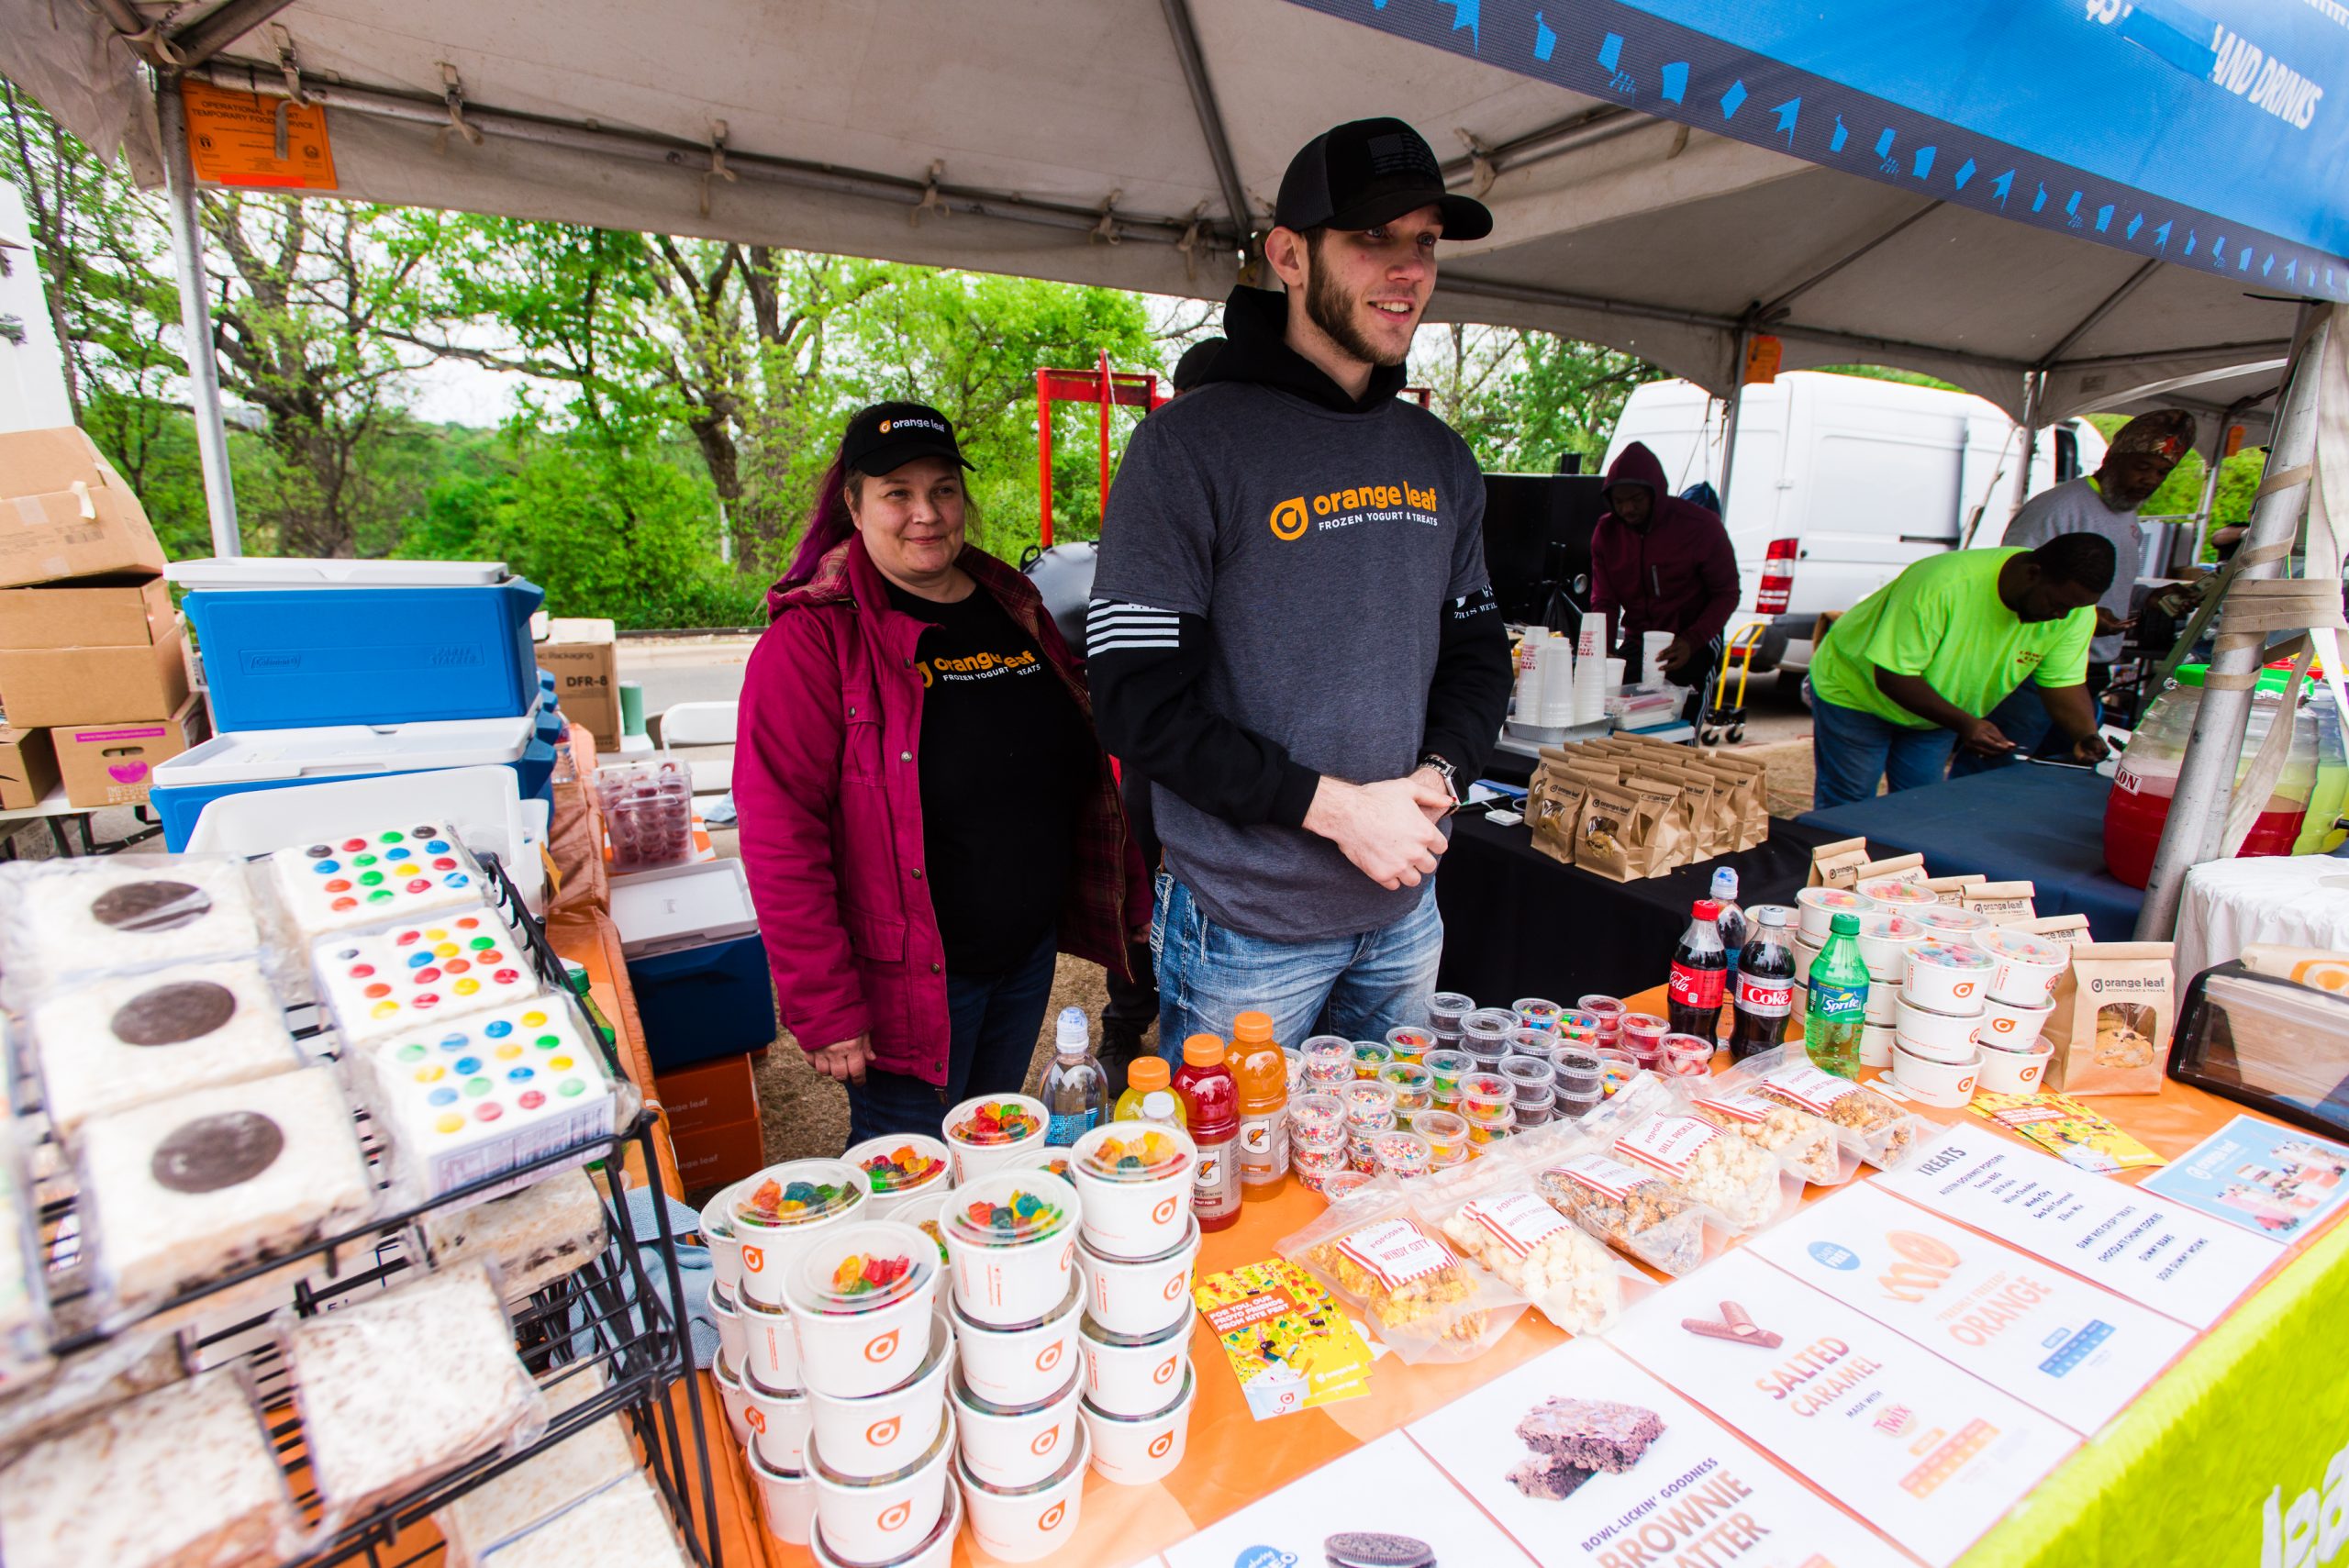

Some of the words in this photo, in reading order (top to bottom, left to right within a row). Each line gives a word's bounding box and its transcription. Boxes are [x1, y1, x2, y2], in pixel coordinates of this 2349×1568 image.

[2248, 56, 2323, 130] DRINKS
[191, 107, 249, 120] TEMPORARY
[249, 115, 276, 125] FOOD
[201, 100, 264, 117] OPERATIONAL
[893, 418, 930, 428] orange
[930, 419, 944, 432] leaf
[1314, 485, 1402, 516] orange
[1403, 480, 1437, 512] leaf
[1319, 514, 1364, 531] FROZEN
[1366, 511, 1403, 522] YOGURT
[1406, 512, 1411, 520] &
[1412, 513, 1438, 527] TREATS
[548, 651, 595, 661] Packaging
[1003, 650, 1036, 668] eaf
[566, 674, 608, 687] DFR-8
[942, 673, 974, 682] FROZEN
[974, 666, 1009, 679] YOGURT
[1017, 663, 1041, 676] REATS
[1600, 801, 1619, 811] orange
[1619, 806, 1631, 814] leaf
[1983, 902, 2007, 911] orange
[2007, 900, 2024, 910] leaf
[1670, 971, 1694, 992] Cola
[2104, 978, 2142, 988] orange
[2143, 976, 2165, 987] leaf
[1748, 987, 1789, 1006] Coke
[1822, 996, 1860, 1013] Sprite
[1644, 1121, 1664, 1145] POPCO
[1658, 1139, 1675, 1154] DILL
[1672, 1121, 1698, 1143] PICKLE
[1916, 1146, 1967, 1176] TREATS
[1978, 1153, 2006, 1171] POPCORN
[1370, 1226, 1406, 1248] POPCORN
[2076, 1235, 2095, 1249] GIANT
[2098, 1239, 2130, 1262] CHOCOLATE
[2139, 1212, 2164, 1229] COOKIES
[1379, 1246, 1409, 1262] WINDY
[1408, 1239, 1431, 1252] CITY
[1208, 1307, 1230, 1321] FOR
[1230, 1302, 1252, 1316] YOU,
[1252, 1295, 1273, 1307] OUR
[1213, 1312, 1245, 1327] FROYO
[1245, 1297, 1285, 1317] FRIENDS
[1218, 1318, 1245, 1332] FROM
[1245, 1311, 1267, 1323] KITE
[1267, 1303, 1290, 1317] FEST
[1948, 1274, 2054, 1347] ORANGE
[1754, 1337, 1850, 1400] SALTED
[1790, 1355, 1883, 1418] CARAMEL
[1844, 1401, 1867, 1418] MADE
[1864, 1389, 1884, 1405] WITH
[1581, 1495, 1658, 1552] BOWL-LICKIN'
[1660, 1456, 1719, 1499] GOODNESS
[2260, 1440, 2349, 1568] lea
[1597, 1469, 1753, 1568] BROWNIE
[1672, 1512, 1772, 1568] ATTER
